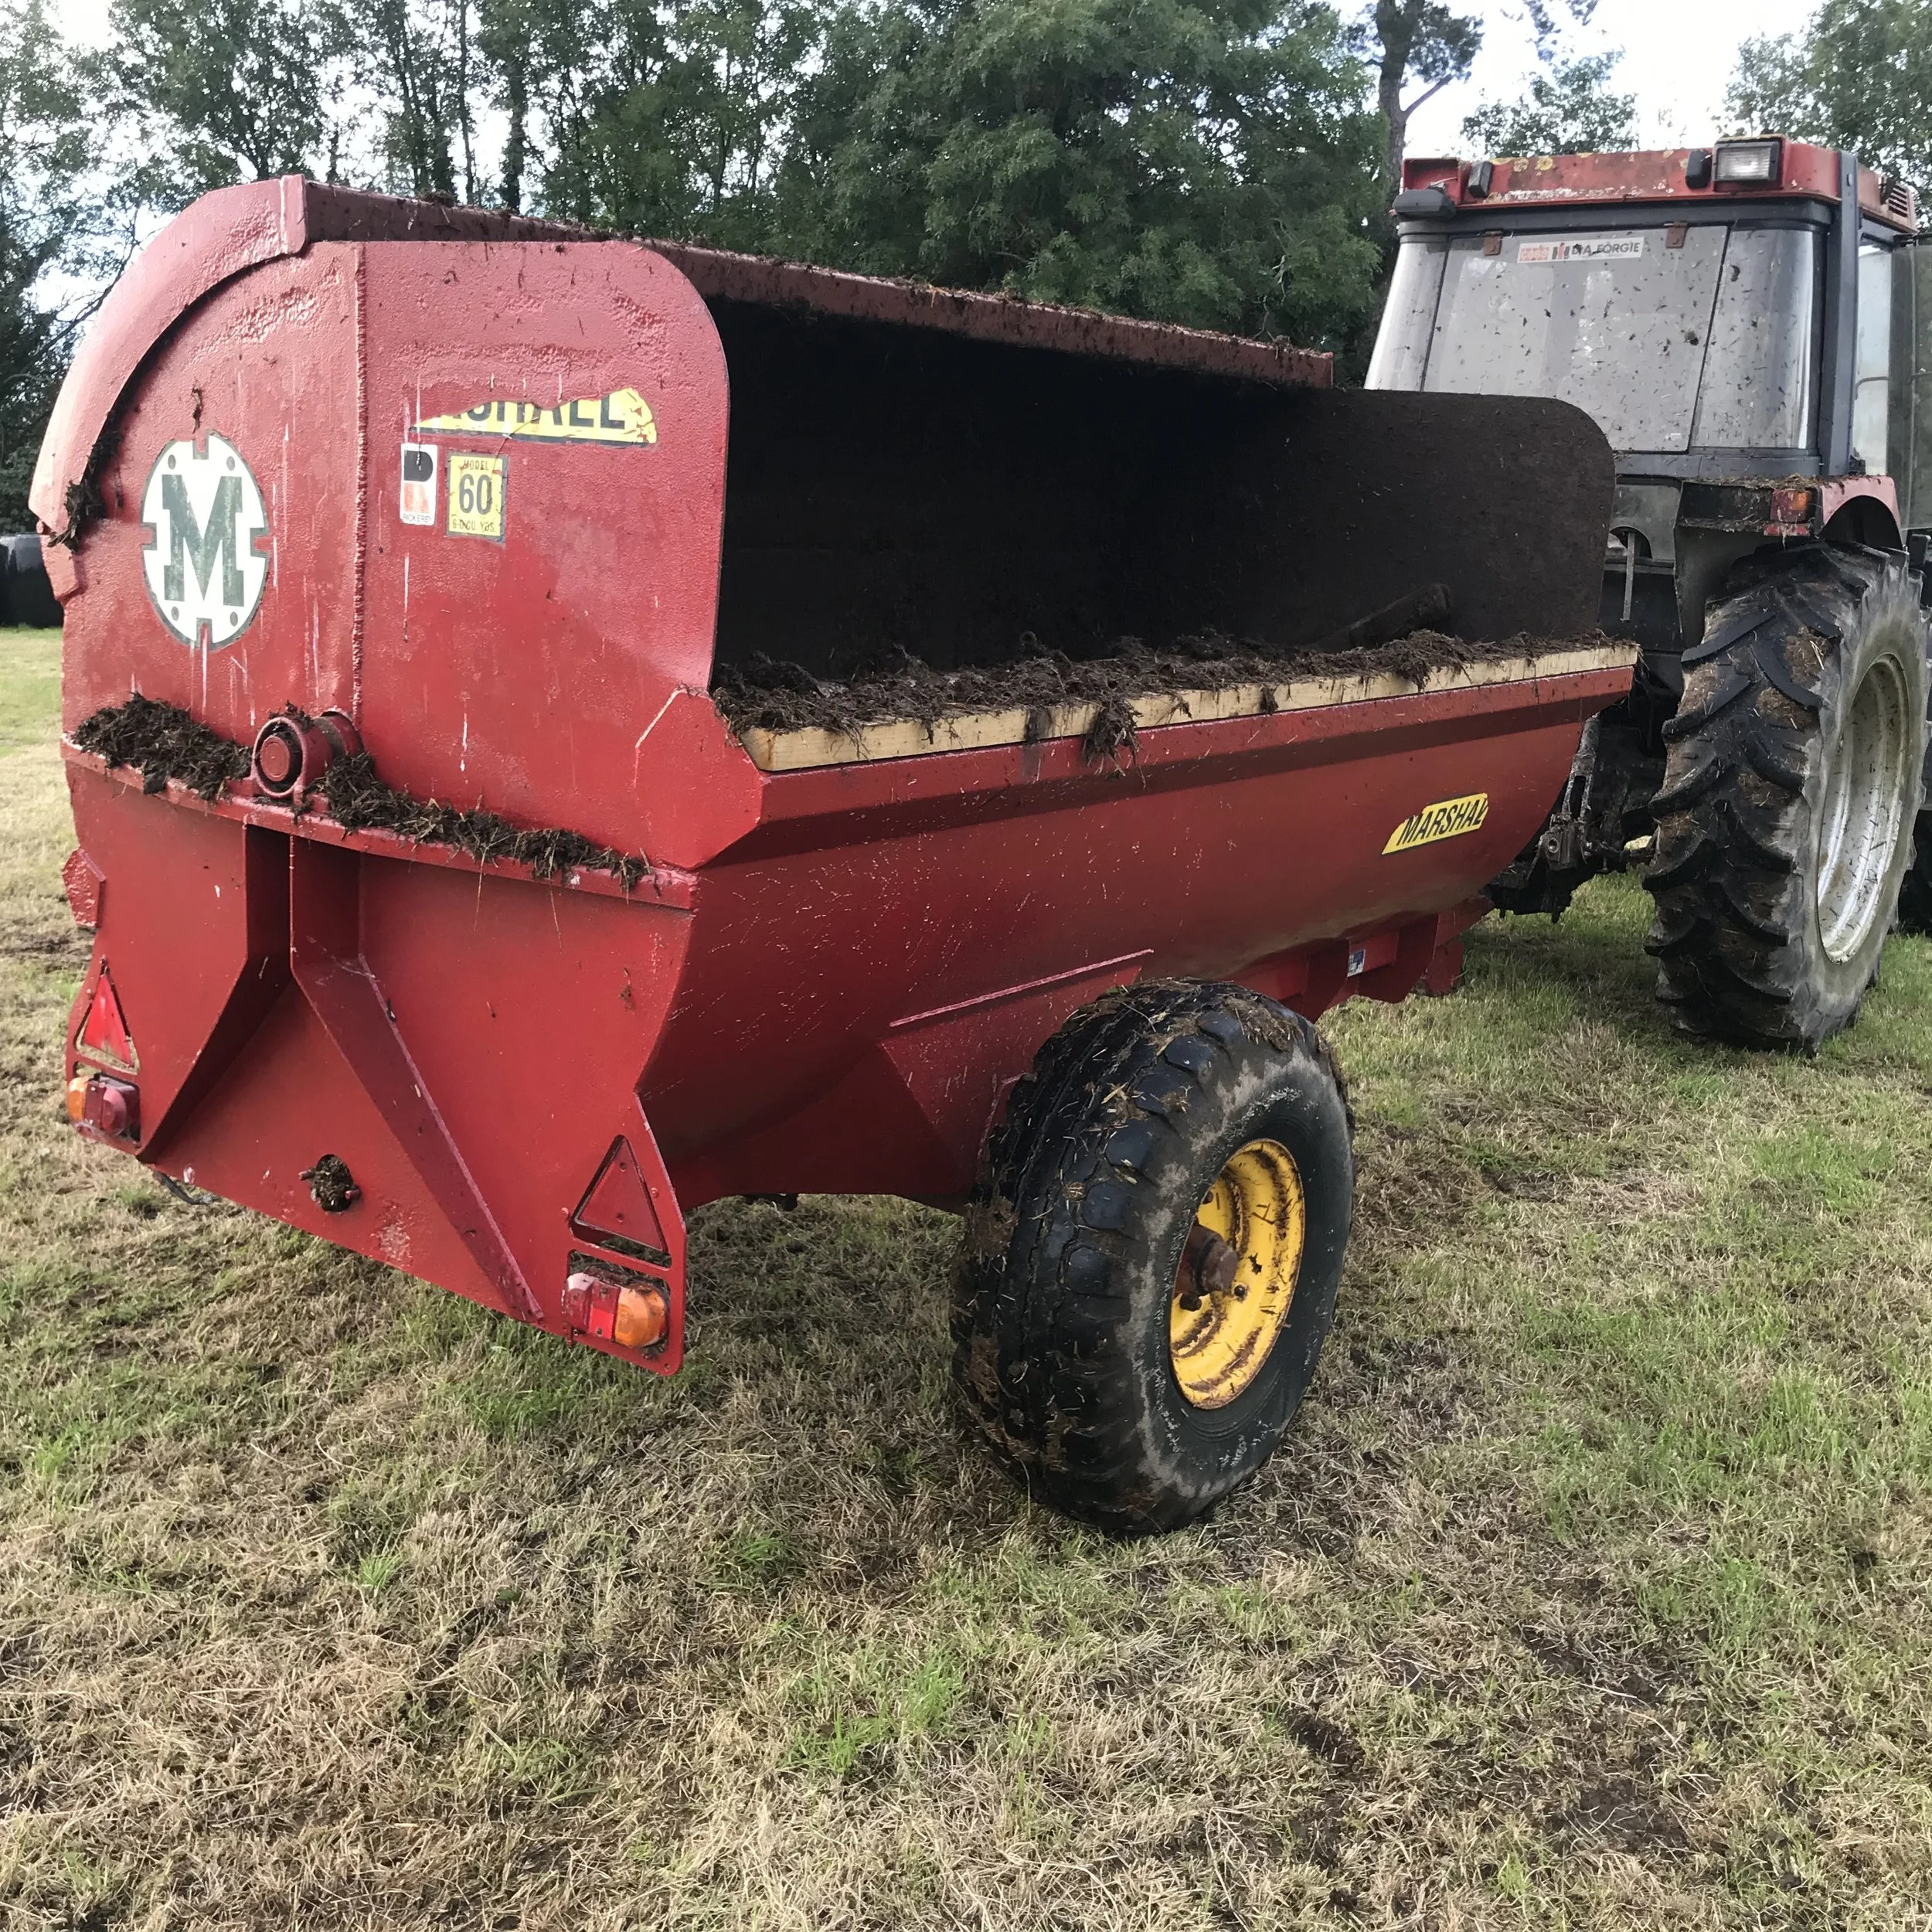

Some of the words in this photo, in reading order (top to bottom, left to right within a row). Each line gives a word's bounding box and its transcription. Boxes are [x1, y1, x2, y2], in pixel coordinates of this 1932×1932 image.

[1597, 242, 1640, 253] FORGIE
[464, 459, 488, 471] MODEL
[458, 473, 493, 515] 60
[162, 474, 244, 607] M
